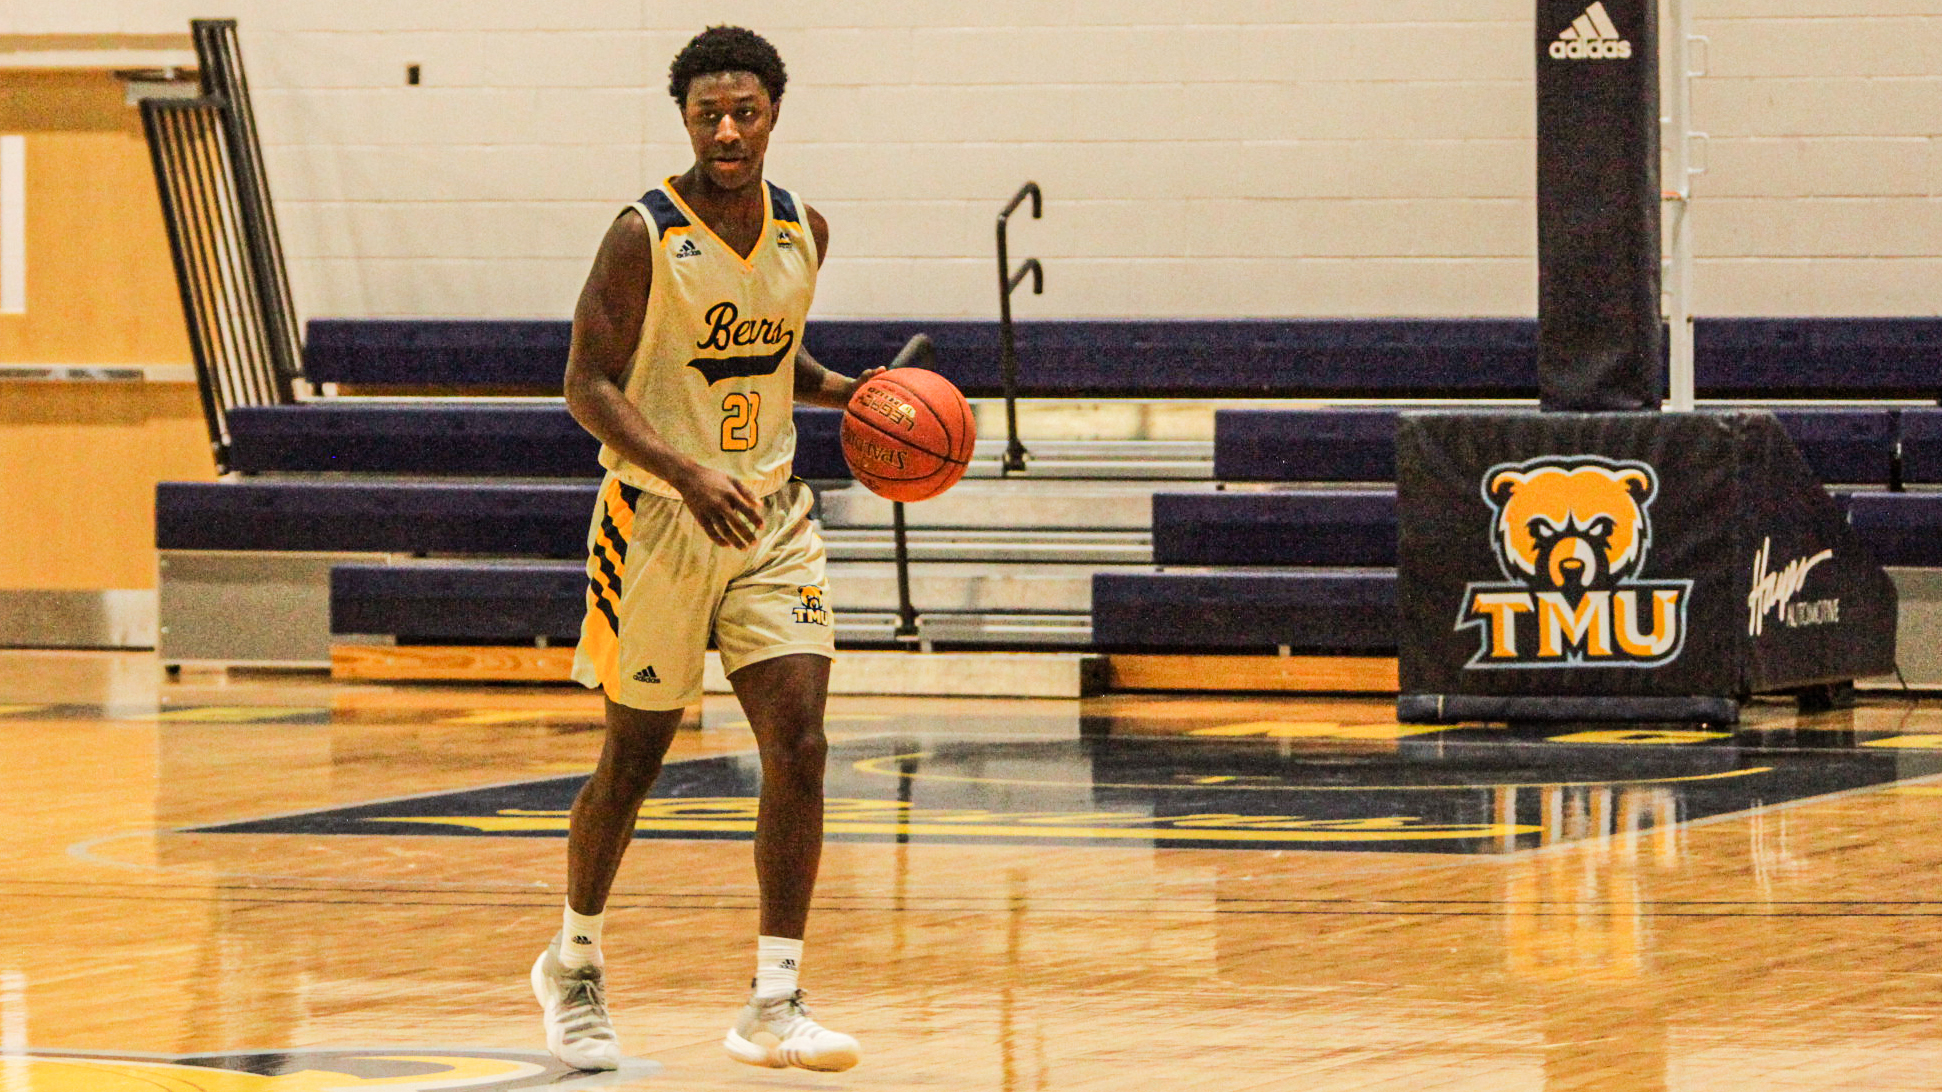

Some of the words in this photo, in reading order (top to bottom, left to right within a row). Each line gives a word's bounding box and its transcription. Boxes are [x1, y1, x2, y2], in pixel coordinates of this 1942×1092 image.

[1549, 38, 1632, 59] adidas
[792, 607, 829, 626] TMU
[1472, 590, 1680, 657] TMU
[632, 674, 661, 684] adidas
